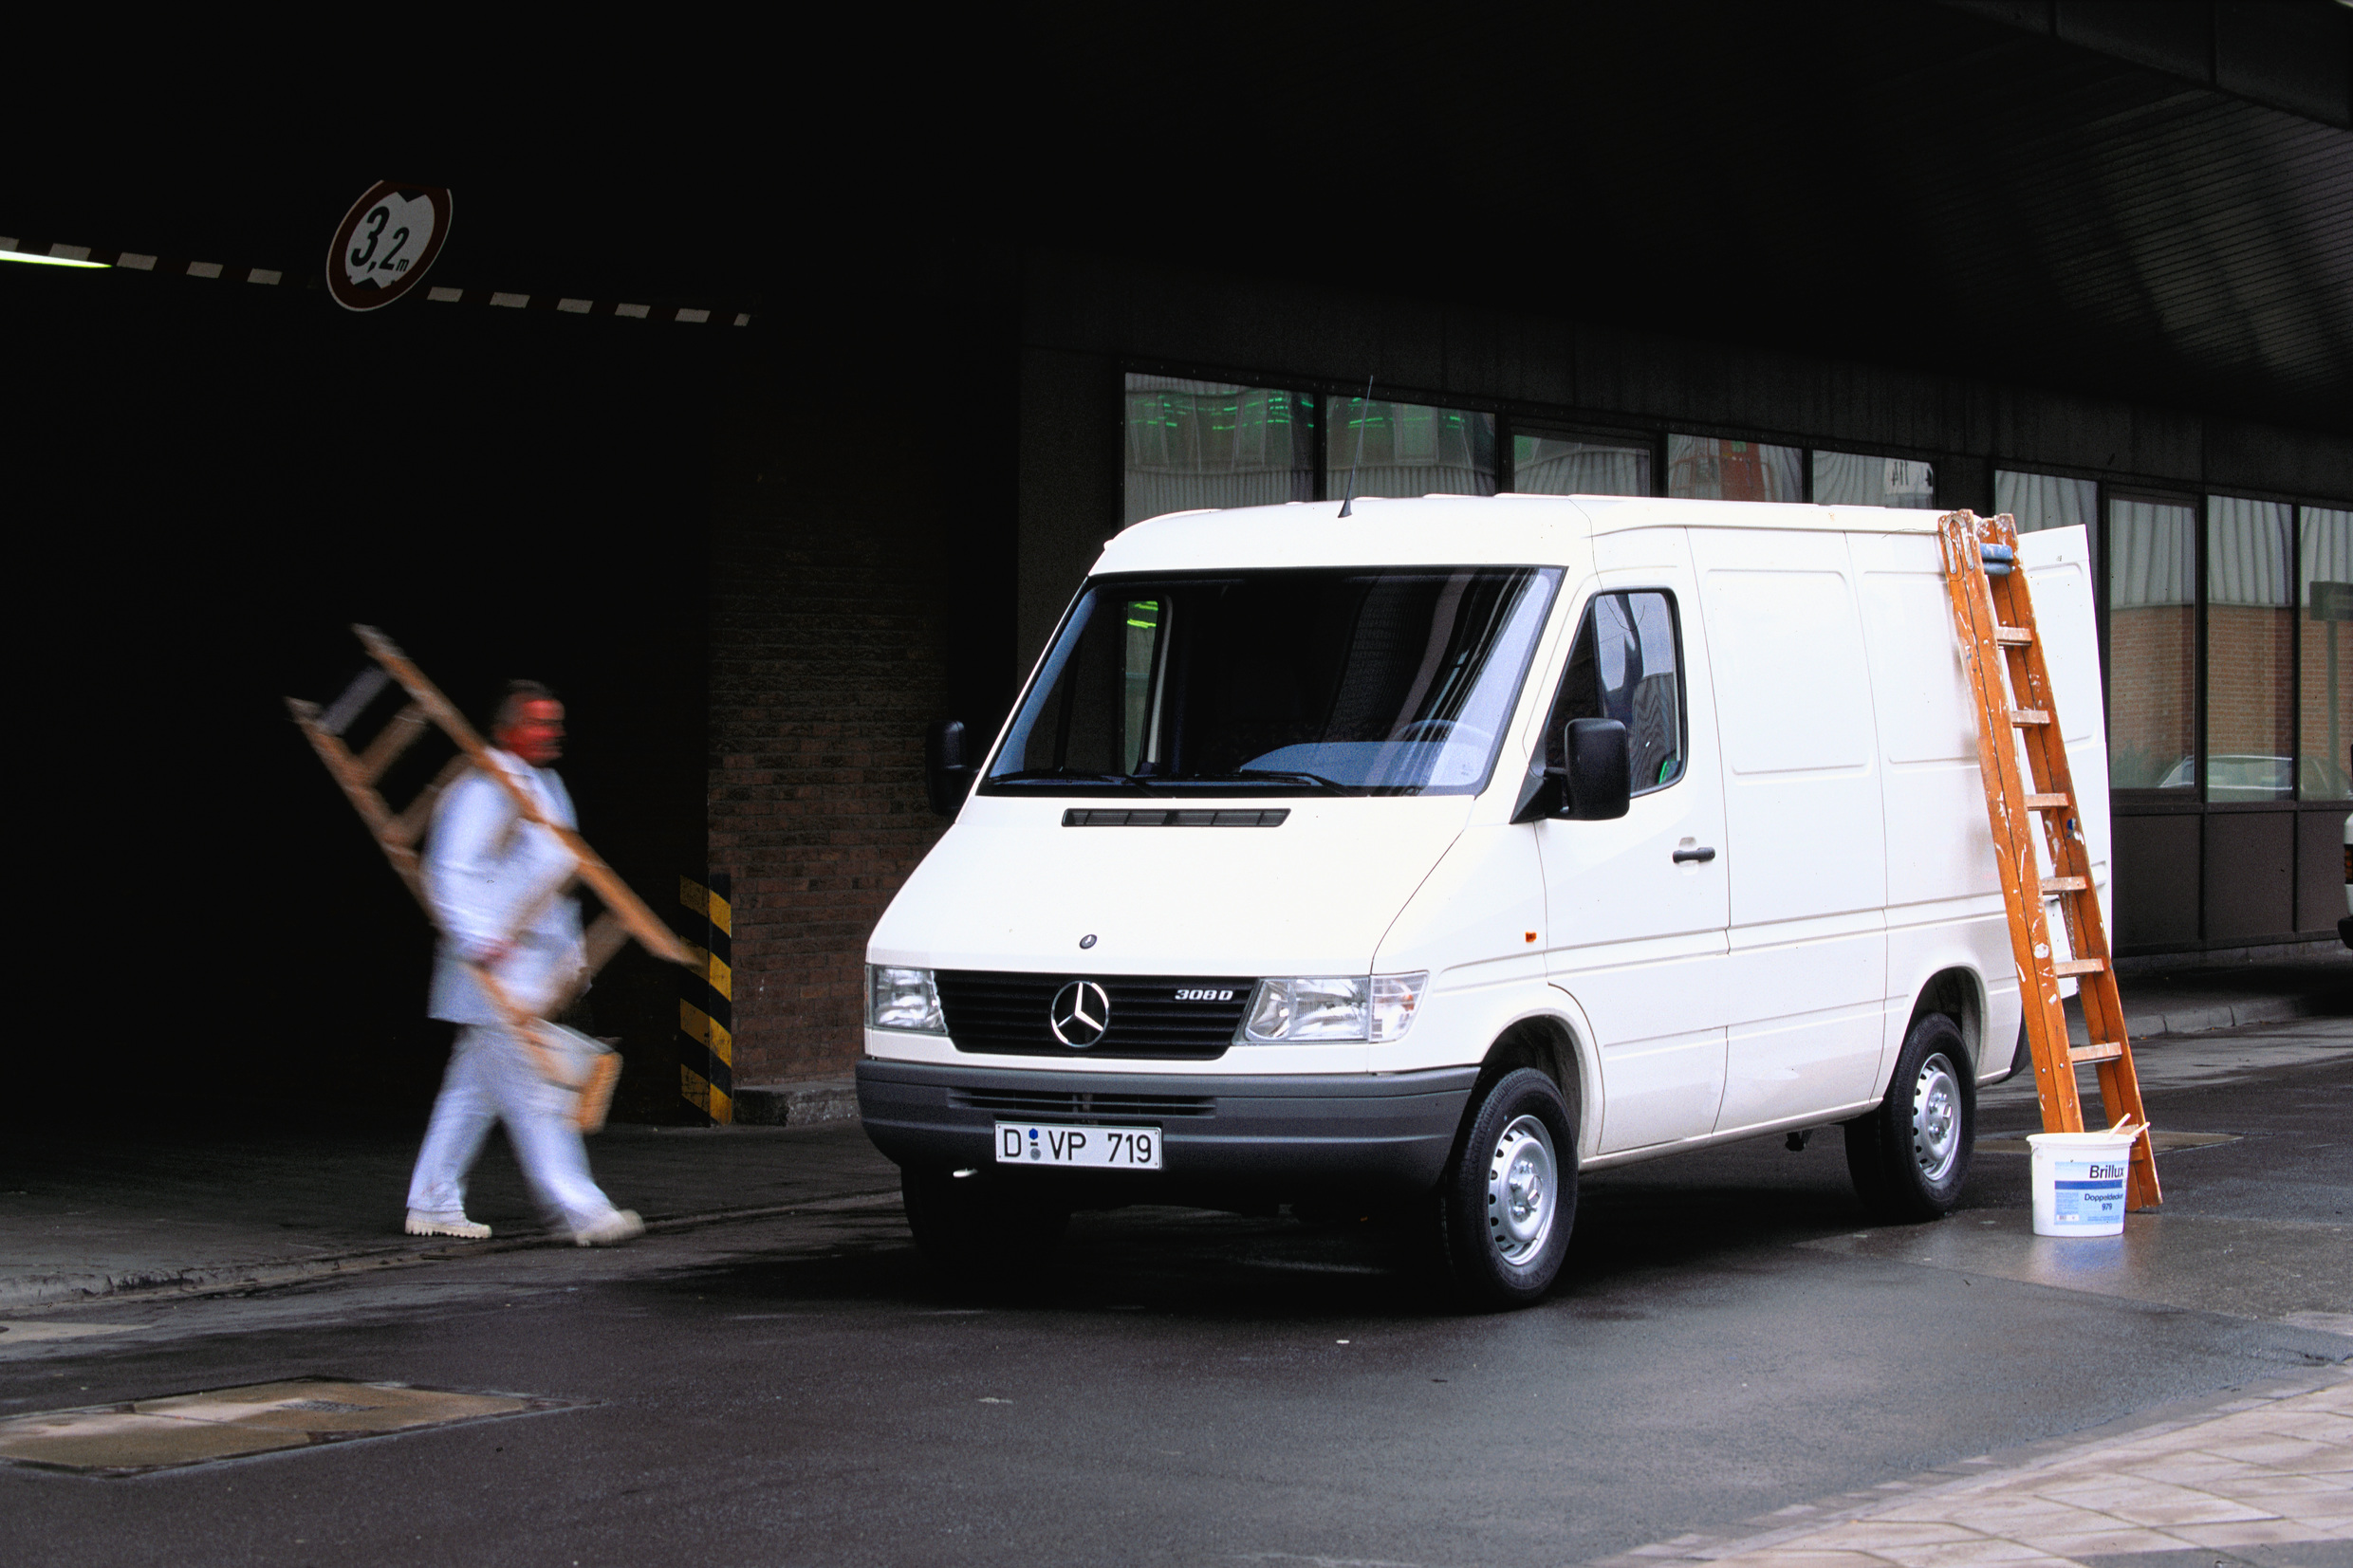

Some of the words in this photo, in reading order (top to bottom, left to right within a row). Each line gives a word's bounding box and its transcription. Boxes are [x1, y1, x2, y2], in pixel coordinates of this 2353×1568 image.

[1048, 1130, 1086, 1161] VP
[1107, 1133, 1152, 1163] 719
[2089, 1164, 2124, 1179] Brillux
